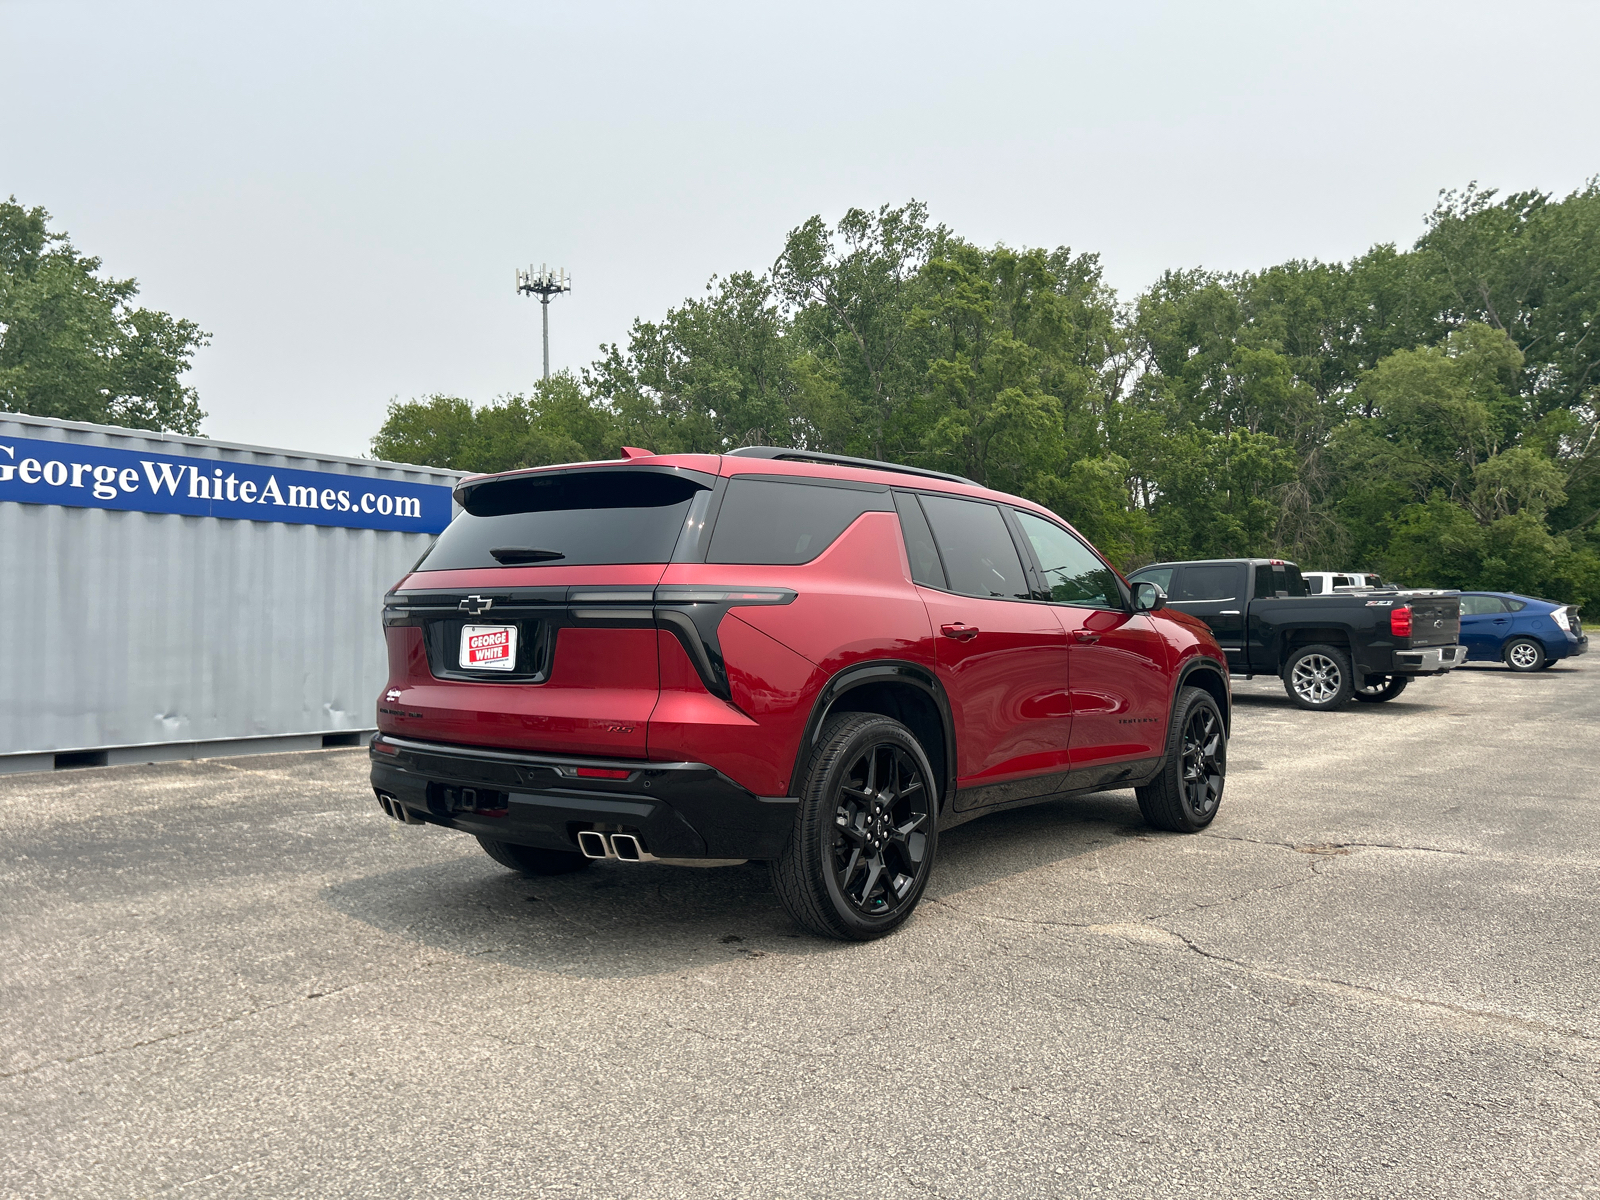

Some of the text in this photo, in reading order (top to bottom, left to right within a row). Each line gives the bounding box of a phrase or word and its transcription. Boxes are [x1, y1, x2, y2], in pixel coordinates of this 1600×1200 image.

[471, 632, 507, 648] GEORGE
[475, 646, 503, 661] WHITE
[606, 725, 635, 734] RS
